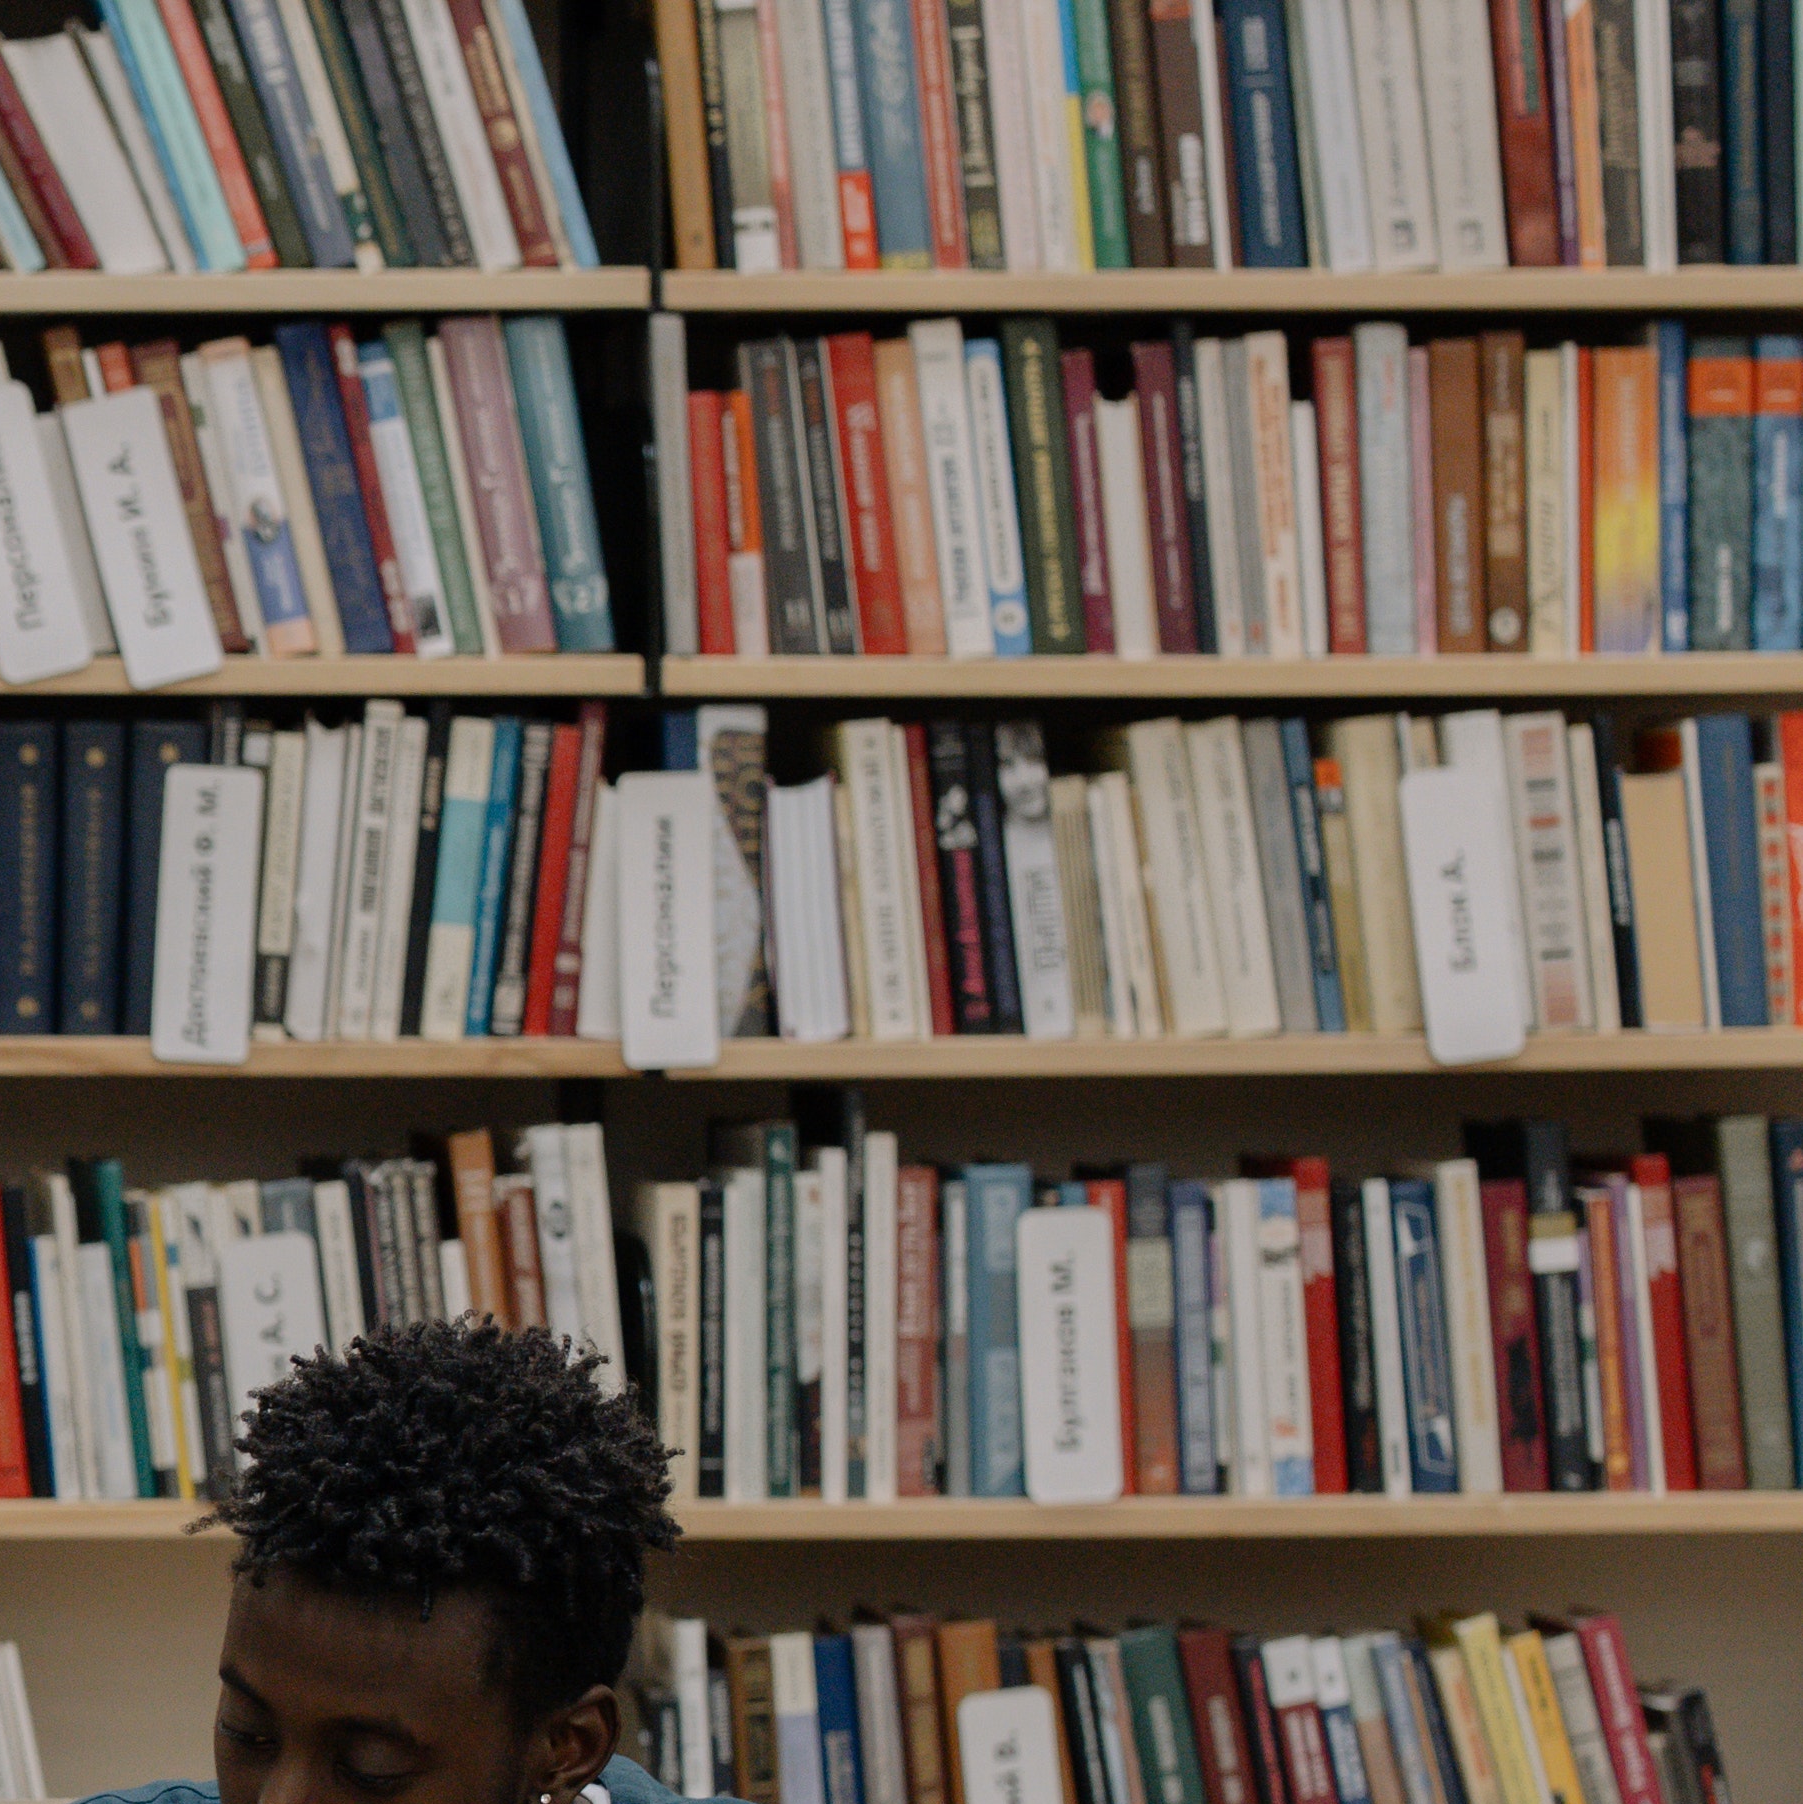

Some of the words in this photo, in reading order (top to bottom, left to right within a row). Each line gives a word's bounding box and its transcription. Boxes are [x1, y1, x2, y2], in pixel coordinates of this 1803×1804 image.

[107, 440, 134, 477] А.
[121, 484, 143, 520] И.
[133, 525, 175, 629] Бунин
[194, 778, 221, 818] М.
[192, 823, 218, 858] Ф.
[1438, 850, 1466, 886] А.
[648, 816, 678, 1019] Персоналии
[1448, 891, 1478, 975] Блок
[180, 867, 216, 1047] Достоевский
[255, 1272, 281, 1305] С.
[1054, 1251, 1076, 1295] М.
[259, 1311, 285, 1345] А.
[1054, 1306, 1085, 1453] Булгаков
[995, 1730, 1022, 1762] В.
